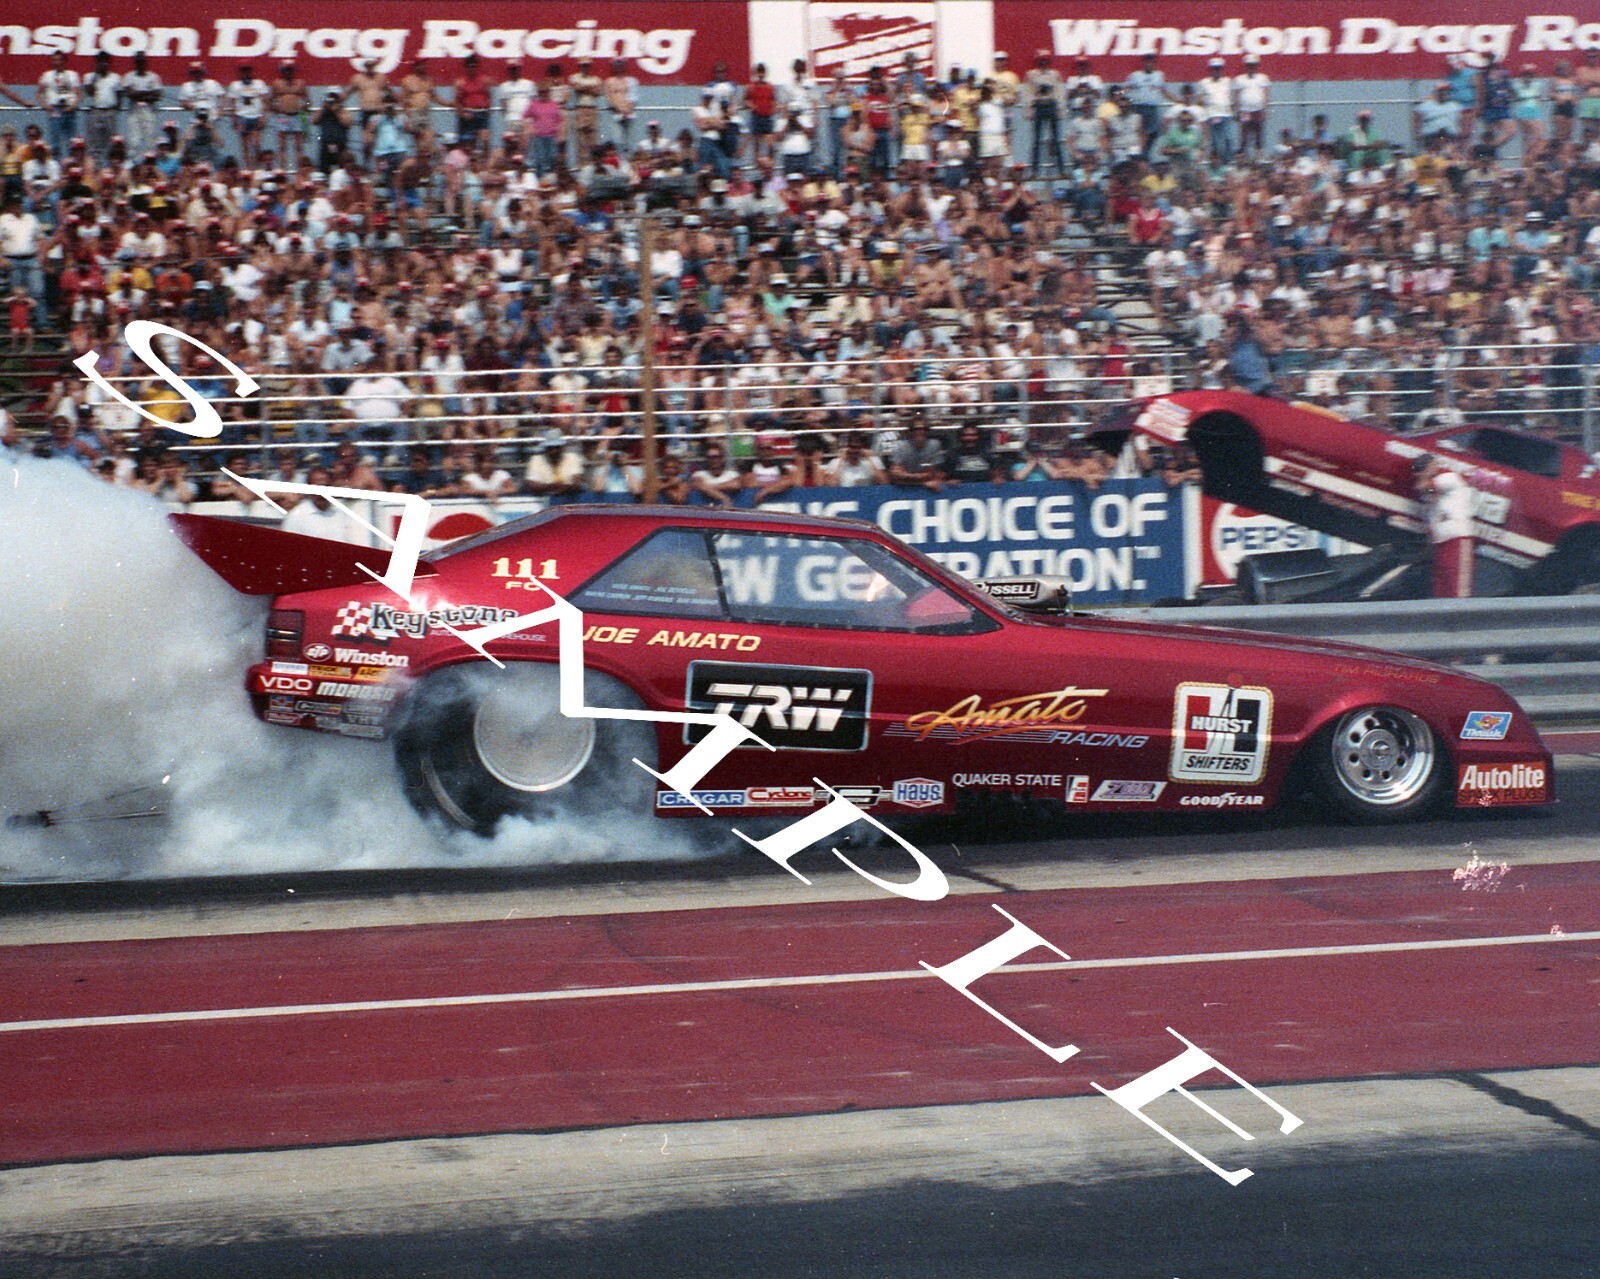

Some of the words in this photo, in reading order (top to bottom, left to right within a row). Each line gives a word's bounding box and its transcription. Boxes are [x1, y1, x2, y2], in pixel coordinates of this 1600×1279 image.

[209, 19, 411, 73] Drag
[418, 19, 696, 75] Racing
[1048, 18, 1331, 56] Winston
[1335, 18, 1517, 69] Drag
[877, 495, 1075, 543] CHOICE
[1091, 493, 1168, 538] OF
[1221, 524, 1311, 550] PEPS
[491, 557, 560, 579] 111
[505, 581, 541, 591] FC
[583, 626, 640, 644] JOE
[646, 629, 762, 651] AMATO
[334, 647, 410, 668] Winston
[260, 675, 313, 691] VDO
[706, 682, 853, 732] TRW
[904, 686, 1110, 743] Amato
[1191, 715, 1253, 734] HURST
[1050, 731, 1149, 749] RACING
[1186, 755, 1251, 771] SHIFTERS
[952, 773, 1010, 786] QUAKER
[1015, 774, 1062, 787] STATE
[1459, 763, 1545, 790] Autolite
[662, 793, 743, 805] CRAGAR
